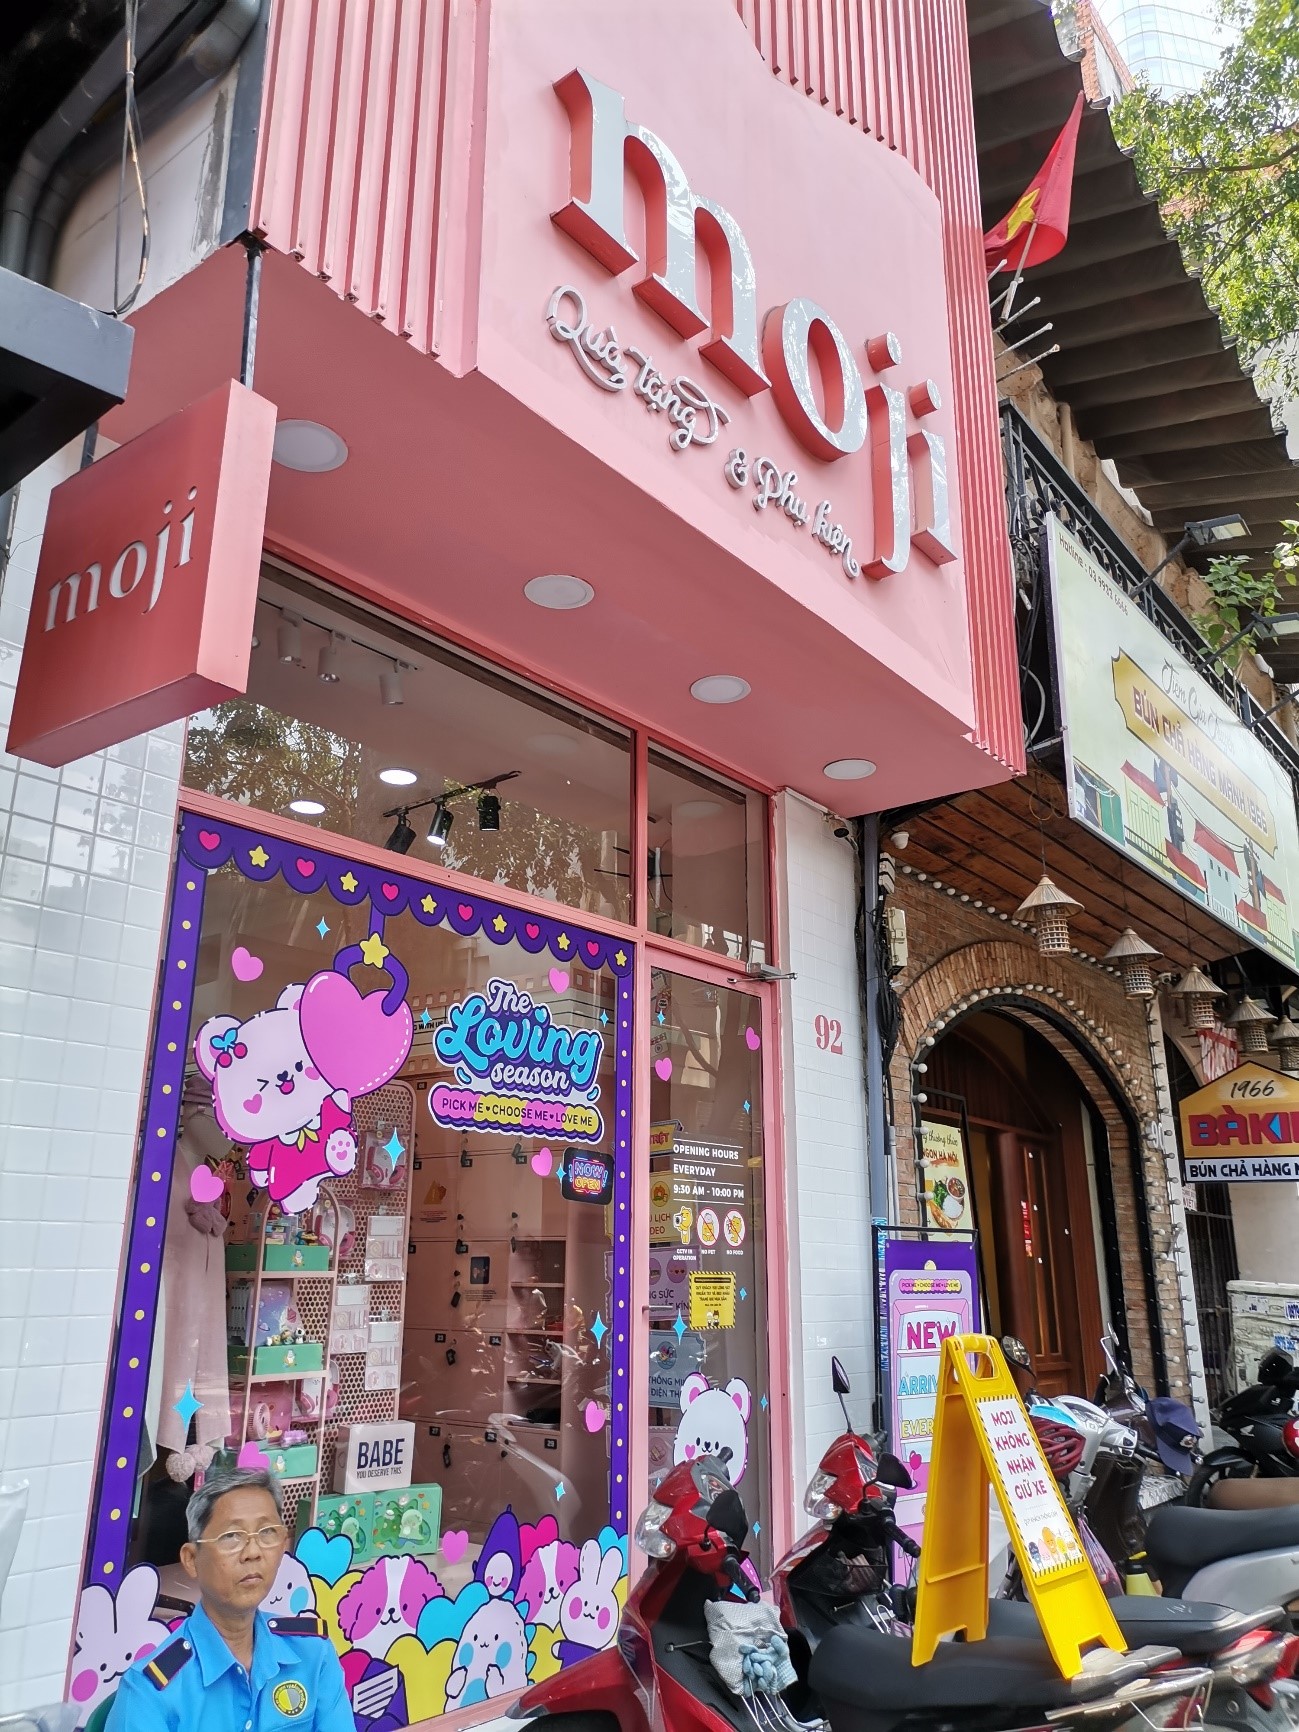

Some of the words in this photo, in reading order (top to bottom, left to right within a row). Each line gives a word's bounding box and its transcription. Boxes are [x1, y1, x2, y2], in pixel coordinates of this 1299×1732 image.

[551, 66, 957, 580] moji
[546, 284, 628, 392] Quà
[44, 485, 198, 632] moji
[1132, 686, 1160, 738] BÚN
[1162, 714, 1187, 758] CHẢ
[489, 980, 532, 1013] The
[436, 998, 601, 1084] Loving
[815, 1014, 844, 1055] 92
[490, 1062, 570, 1090] season
[1230, 1080, 1275, 1098] 1966
[442, 1097, 467, 1111] PICK
[468, 1100, 484, 1113] ME
[492, 1104, 532, 1119] CHOOSE
[534, 1110, 549, 1121] ME
[555, 1113, 579, 1125] LOVE
[580, 1116, 593, 1126] ME
[673, 1144, 710, 1156] OPENING
[712, 1149, 739, 1159] HOURS
[575, 1162, 603, 1178] NOW
[673, 1164, 716, 1176] EVERYDAY
[1190, 1161, 1217, 1178] BÚN
[1220, 1160, 1248, 1177] CHẢ
[1252, 1159, 1291, 1176] HÀNG
[575, 1176, 600, 1190] OPEN
[673, 1184, 690, 1194] 9:30
[692, 1186, 705, 1195] AM
[712, 1187, 731, 1197] 10:00
[733, 1189, 744, 1198] PM
[907, 1320, 956, 1350] NEW
[991, 1410, 1017, 1426] MOJI
[994, 1431, 1030, 1451] KHÔNG
[357, 1438, 405, 1469] BABE
[1006, 1453, 1036, 1476] NHẬN
[357, 1471, 367, 1479] YOU
[368, 1468, 389, 1478] DESERVE
[390, 1467, 402, 1475] THIS
[1014, 1479, 1032, 1500] GIỮ
[1032, 1480, 1047, 1495] XE
